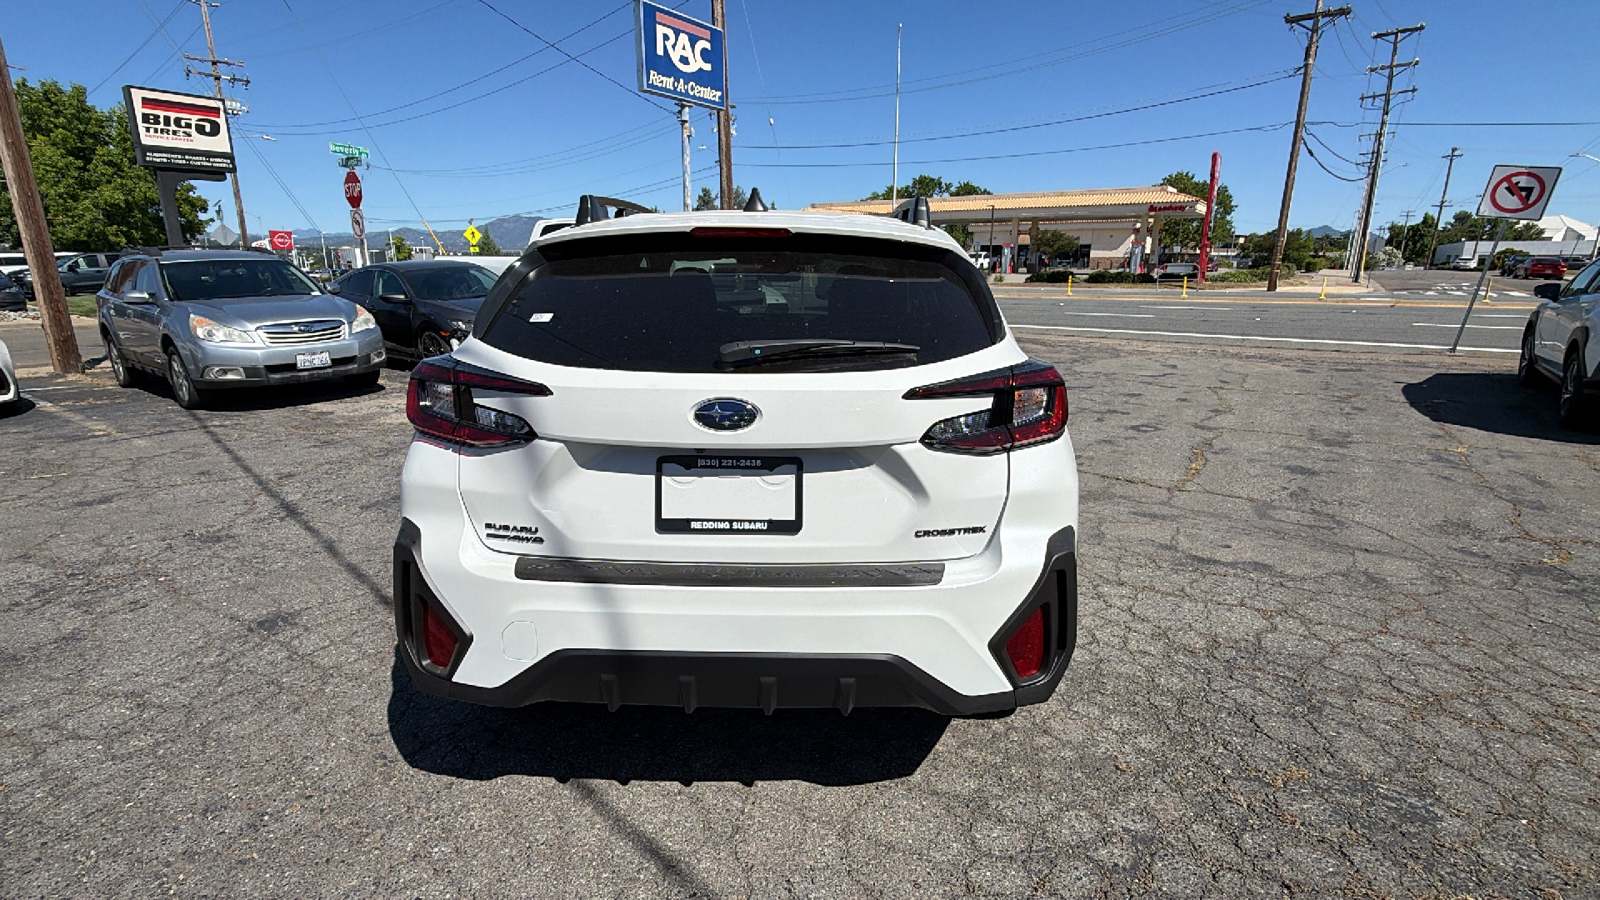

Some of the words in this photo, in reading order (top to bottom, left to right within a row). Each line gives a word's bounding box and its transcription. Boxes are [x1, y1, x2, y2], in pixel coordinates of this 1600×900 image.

[141, 112, 193, 129] BIG
[194, 118, 221, 137] O
[142, 126, 193, 138] TIRES
[330, 143, 359, 157] Beverly
[344, 182, 361, 198] STOP
[697, 458, 719, 468] (530)
[484, 522, 539, 535] SUBARU
[690, 521, 731, 530] REDDING
[732, 521, 768, 530] SUBARU
[914, 525, 987, 538] CROSSTREK
[507, 534, 545, 545] AWD
